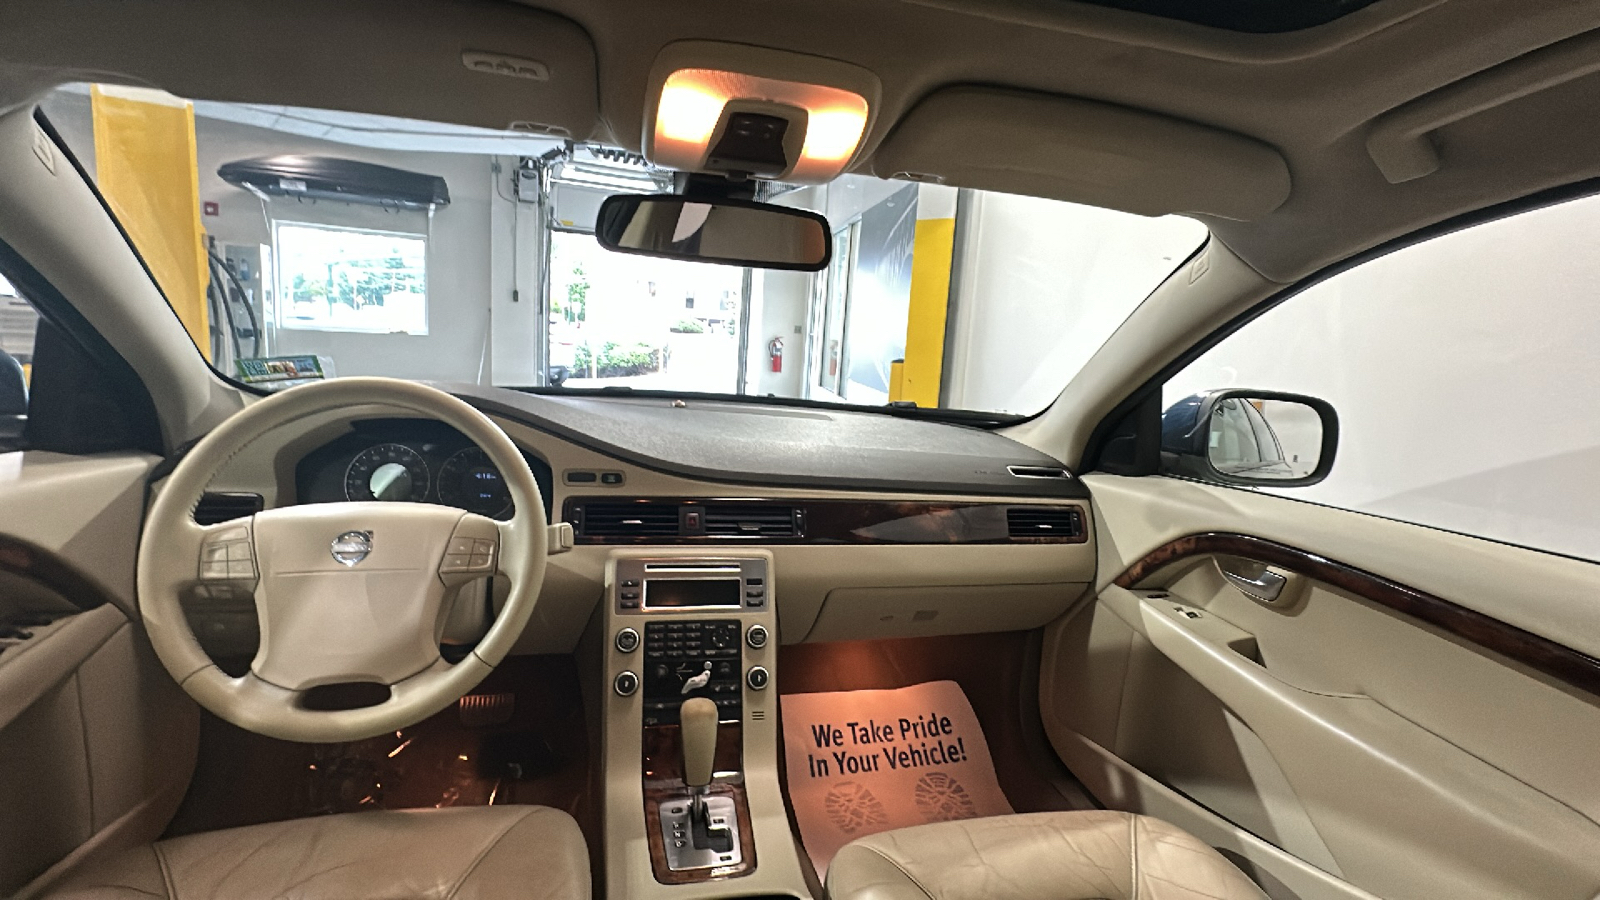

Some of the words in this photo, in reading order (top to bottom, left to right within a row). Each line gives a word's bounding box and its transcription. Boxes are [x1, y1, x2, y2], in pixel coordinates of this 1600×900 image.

[811, 724, 844, 748] We
[847, 719, 894, 745] Take
[898, 712, 953, 740] Pride
[808, 754, 829, 778] In
[832, 751, 879, 775] Your
[882, 737, 967, 770] Vehicle!
